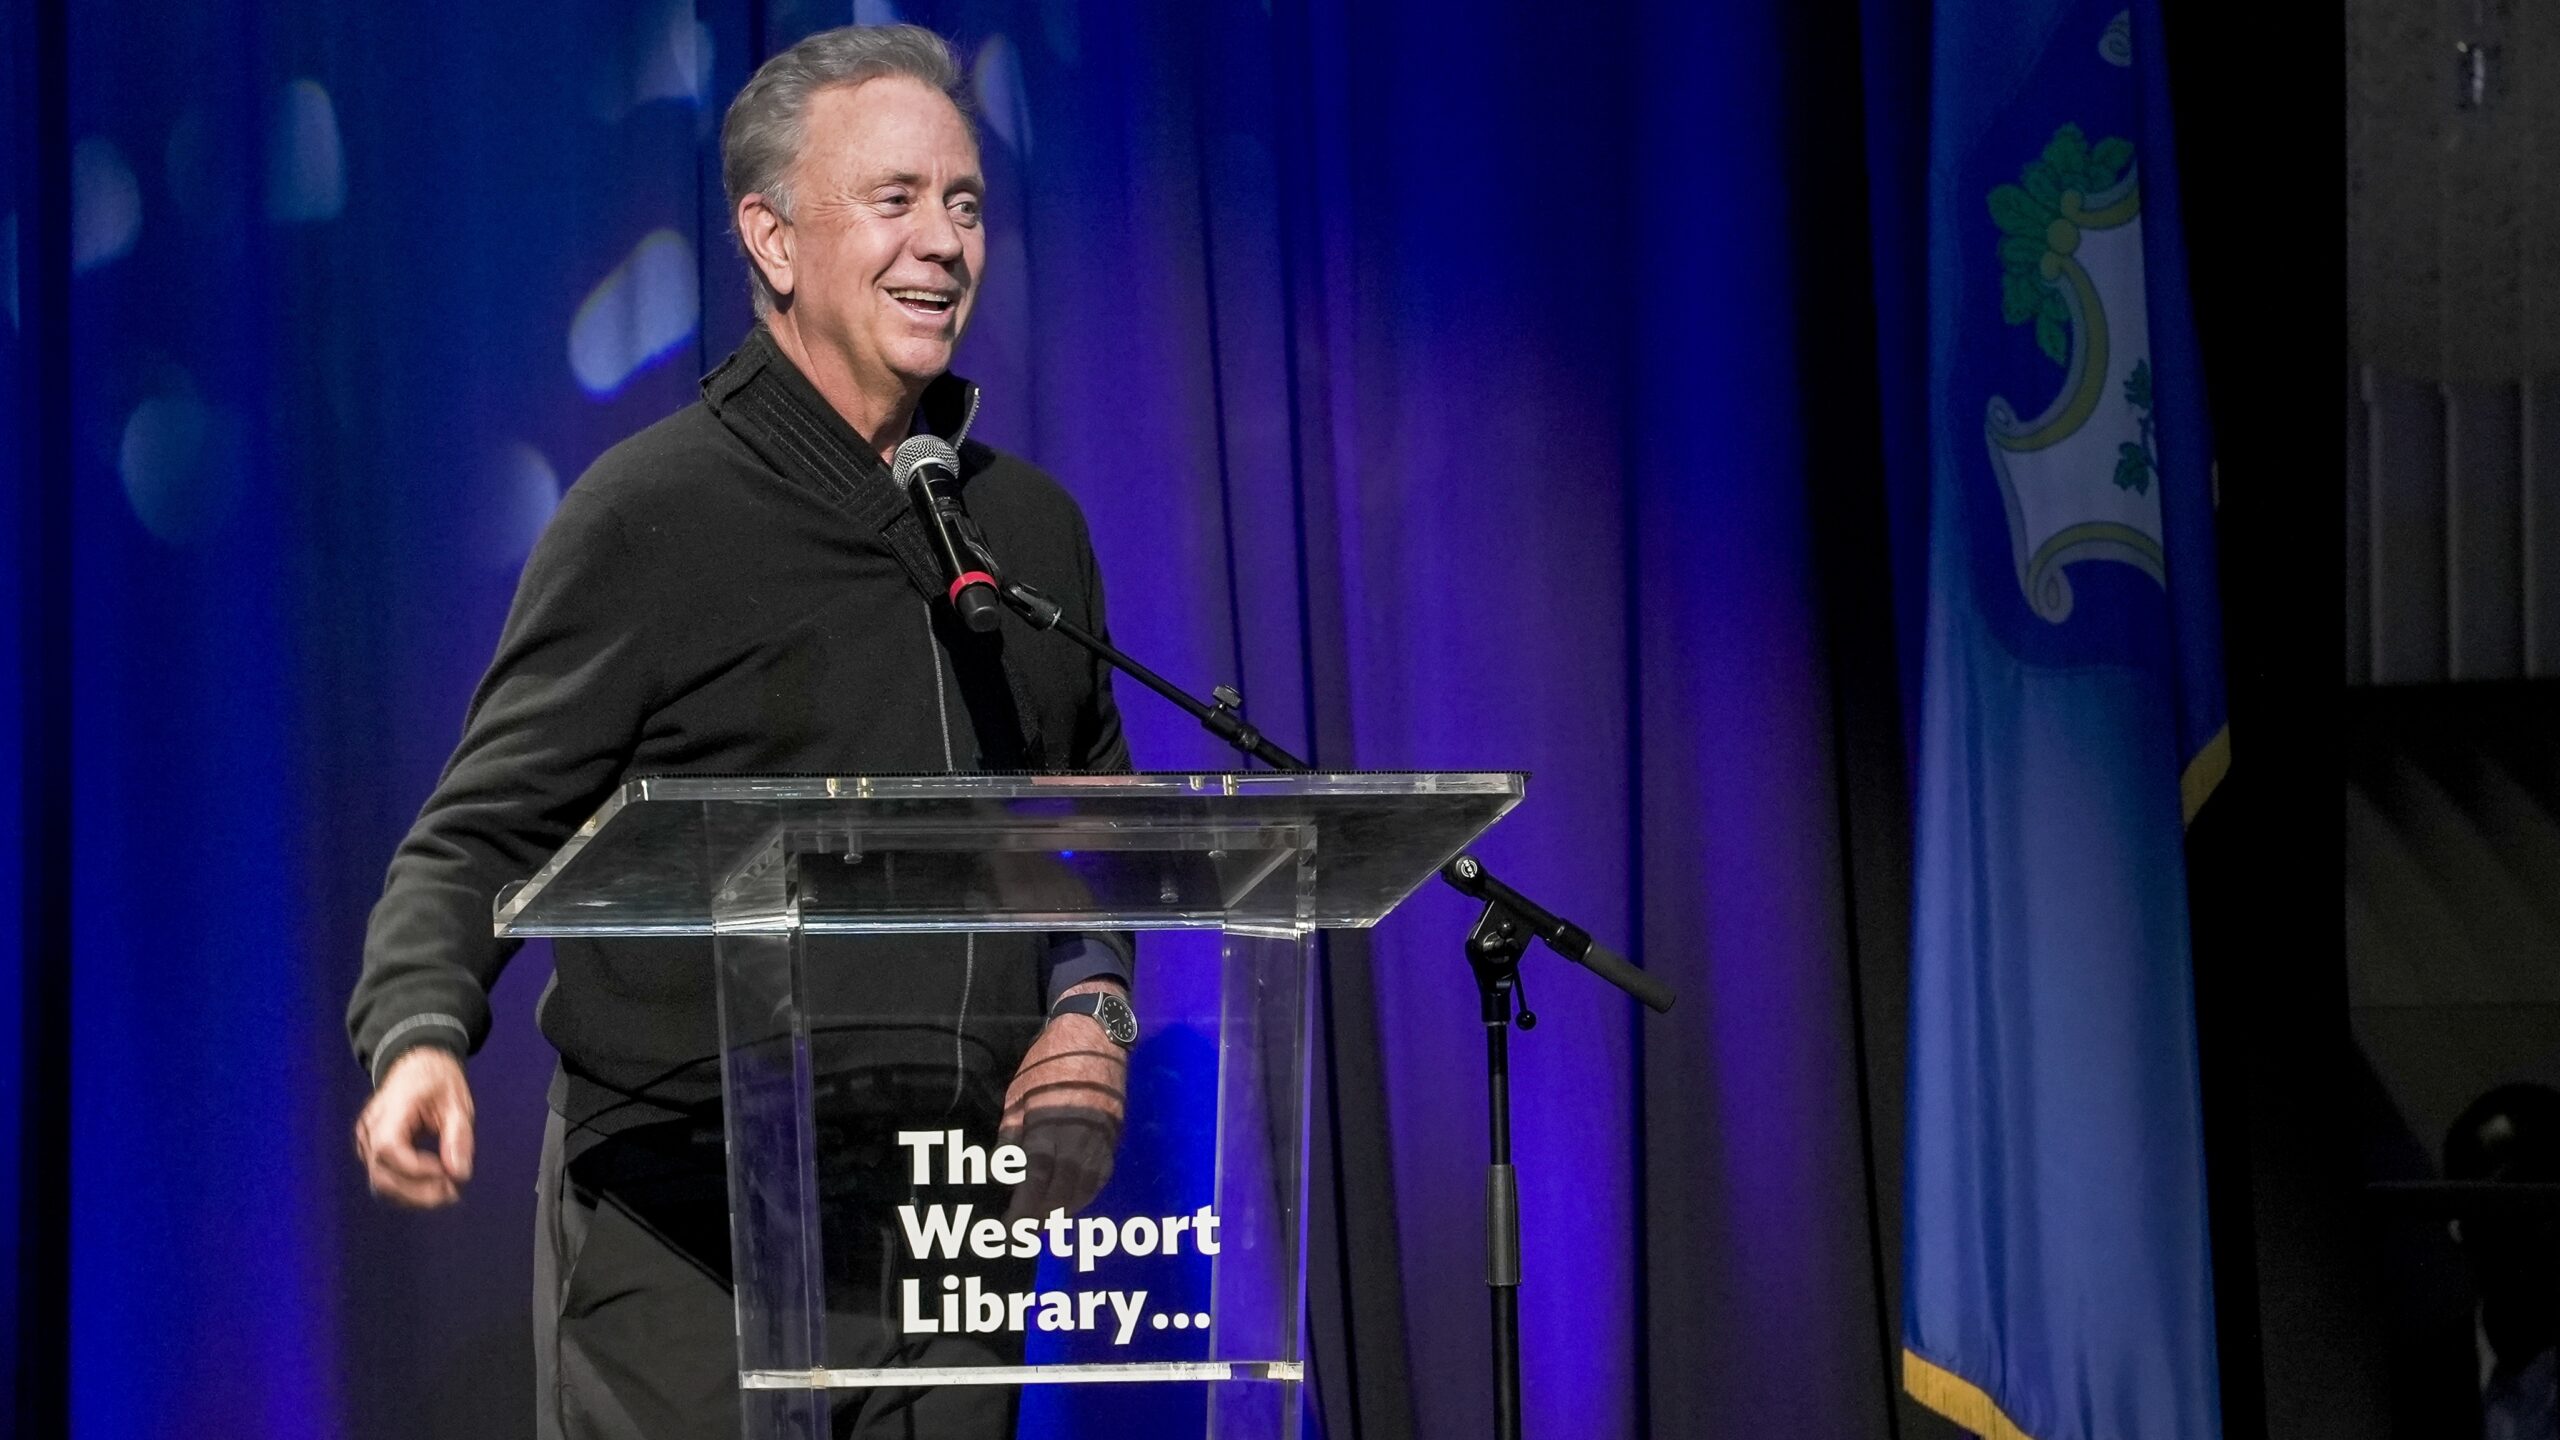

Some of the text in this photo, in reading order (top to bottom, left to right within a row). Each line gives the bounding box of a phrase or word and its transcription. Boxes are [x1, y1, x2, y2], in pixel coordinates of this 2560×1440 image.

[898, 1129, 1028, 1185] The
[898, 1204, 1221, 1272] Westport
[903, 1275, 1211, 1345] Library...
